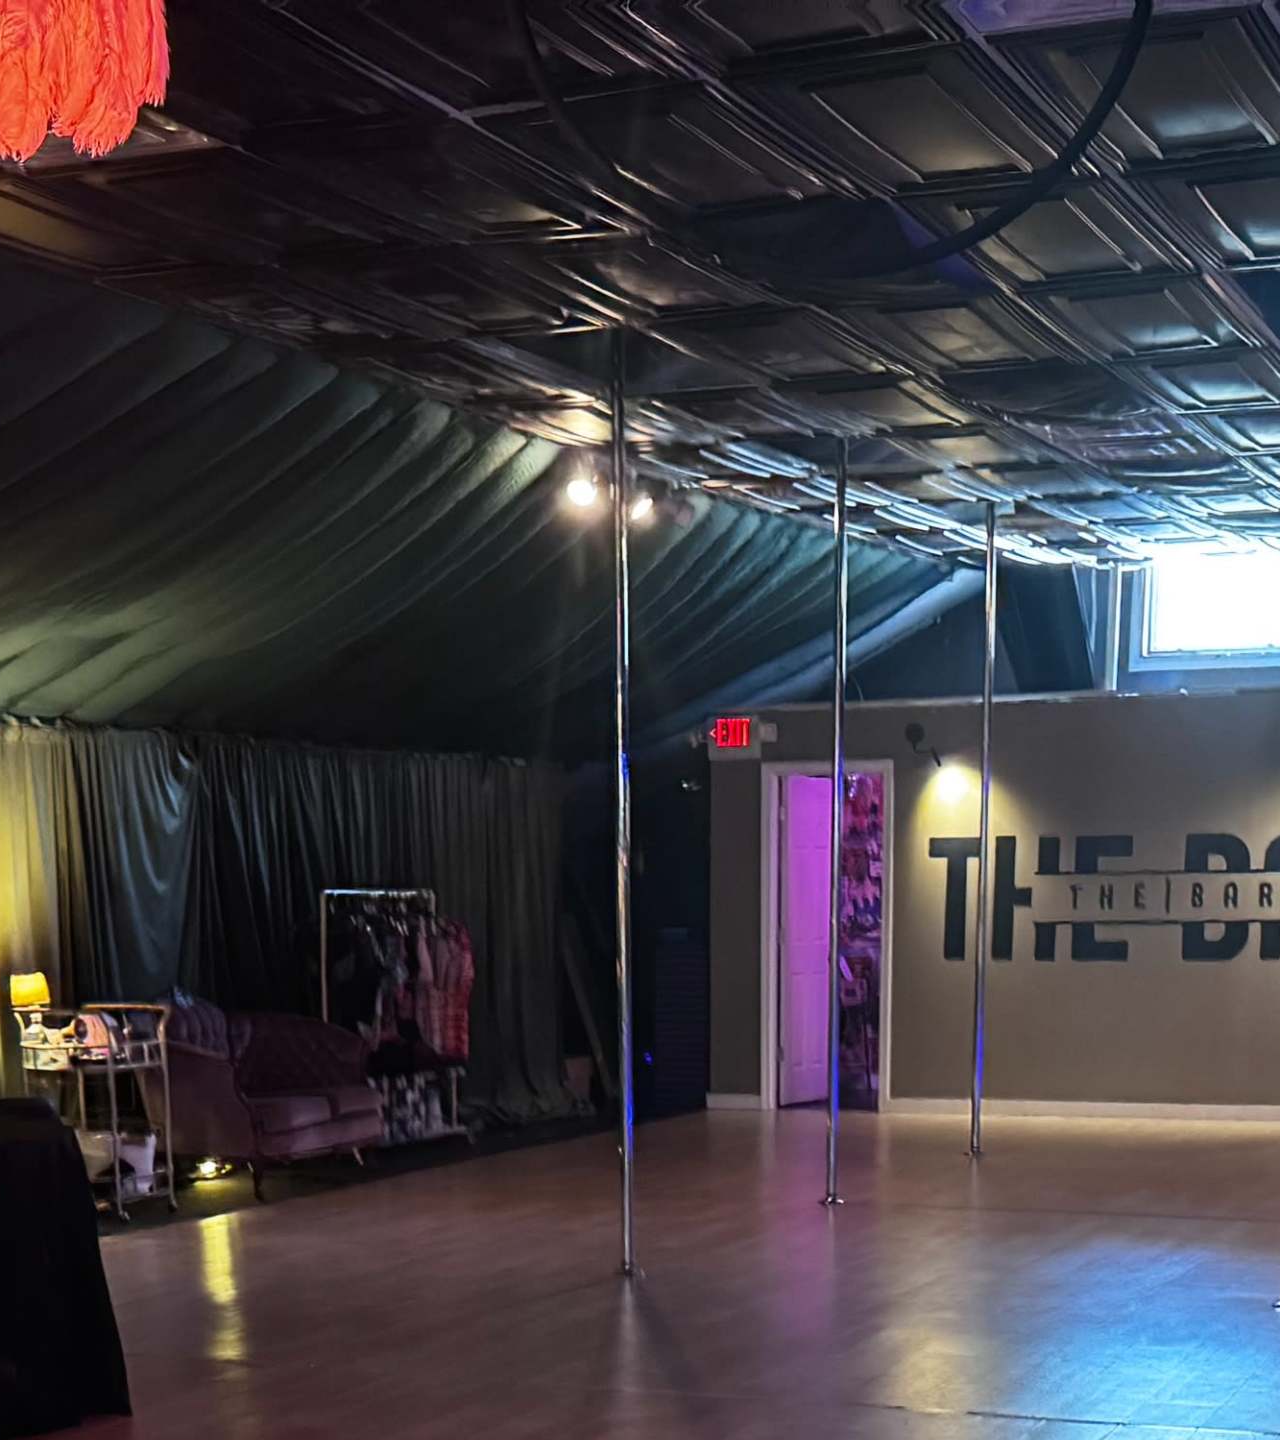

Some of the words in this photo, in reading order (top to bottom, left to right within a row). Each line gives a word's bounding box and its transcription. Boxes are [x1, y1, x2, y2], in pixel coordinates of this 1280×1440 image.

[717, 718, 750, 747] EXIT
[929, 835, 1133, 961] THE
[1070, 882, 1147, 911] THE
[1191, 881, 1273, 909] BAR
